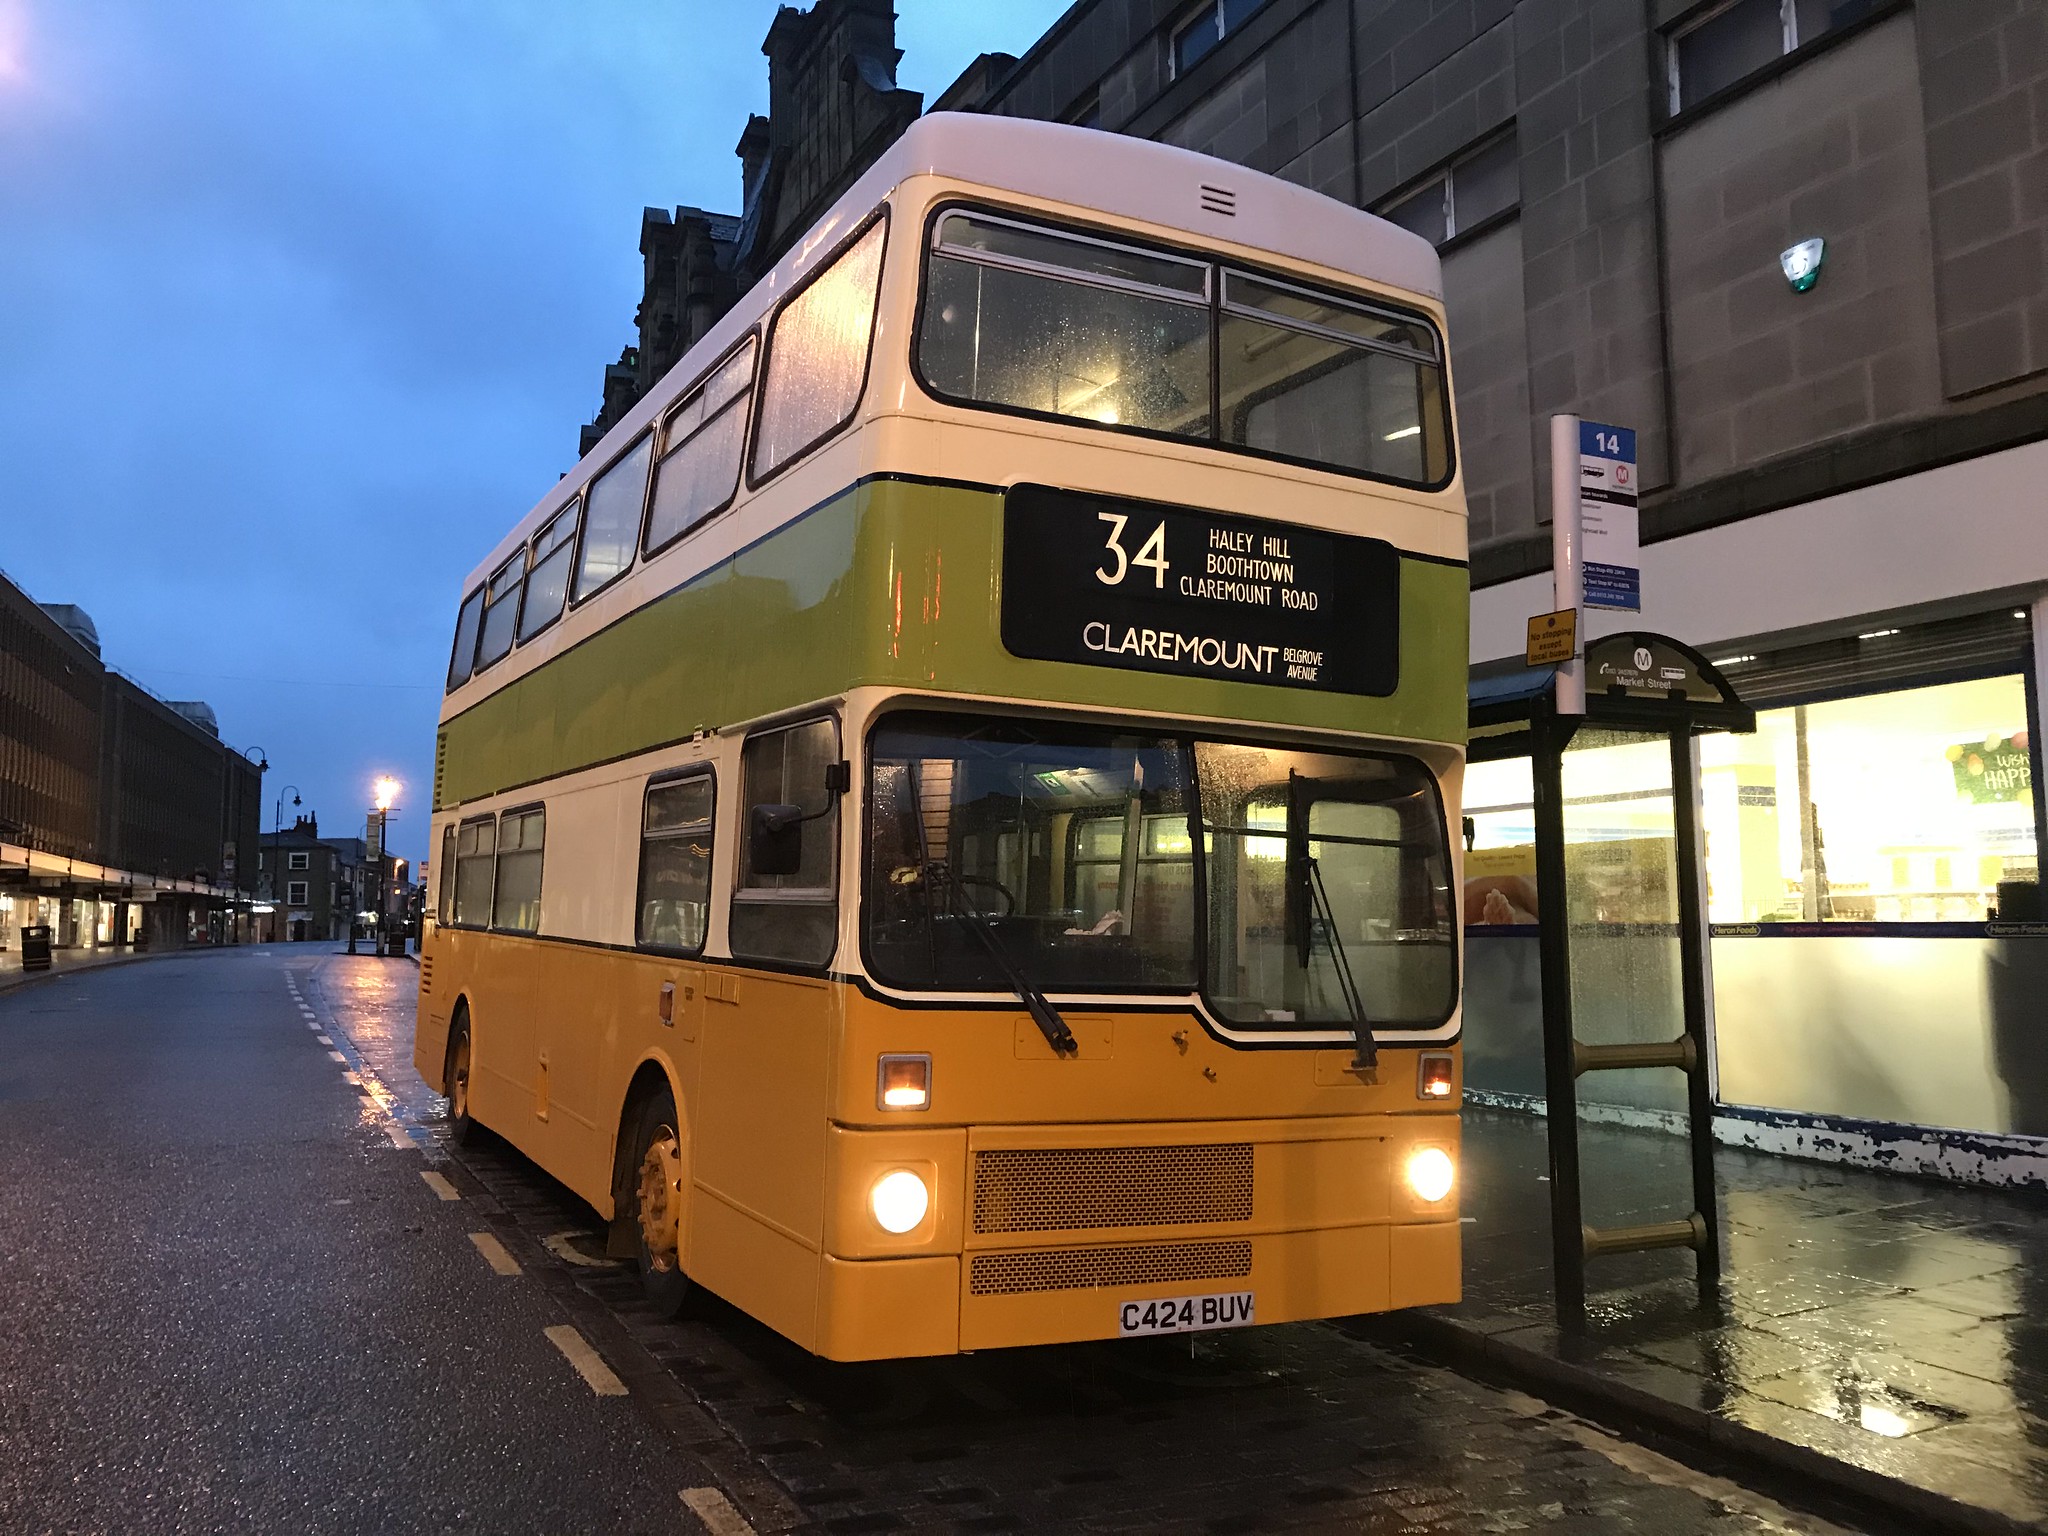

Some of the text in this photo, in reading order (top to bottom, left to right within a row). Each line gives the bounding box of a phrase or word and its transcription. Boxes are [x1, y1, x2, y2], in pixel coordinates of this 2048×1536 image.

[1596, 432, 1620, 454] 14
[1095, 512, 1170, 589] 34
[1209, 528, 1292, 559] HALEY HILL
[1207, 554, 1294, 584] BOOTHTOWN
[1180, 576, 1319, 611] CLAREMOUNT ROAD
[1530, 628, 1572, 641] No stopping
[1539, 640, 1562, 650] except
[1083, 621, 1279, 674] CLAREMOUNT
[1283, 647, 1324, 667] BELGROVE
[1530, 650, 1570, 662] local buses
[1286, 665, 1318, 682] AVENUE
[1616, 676, 1672, 690] Market Street
[1984, 767, 2032, 790] HAPP
[1714, 926, 1758, 934] Heron Foods
[1990, 925, 2018, 934] Heron
[1123, 1295, 1252, 1331] C424 BUV
